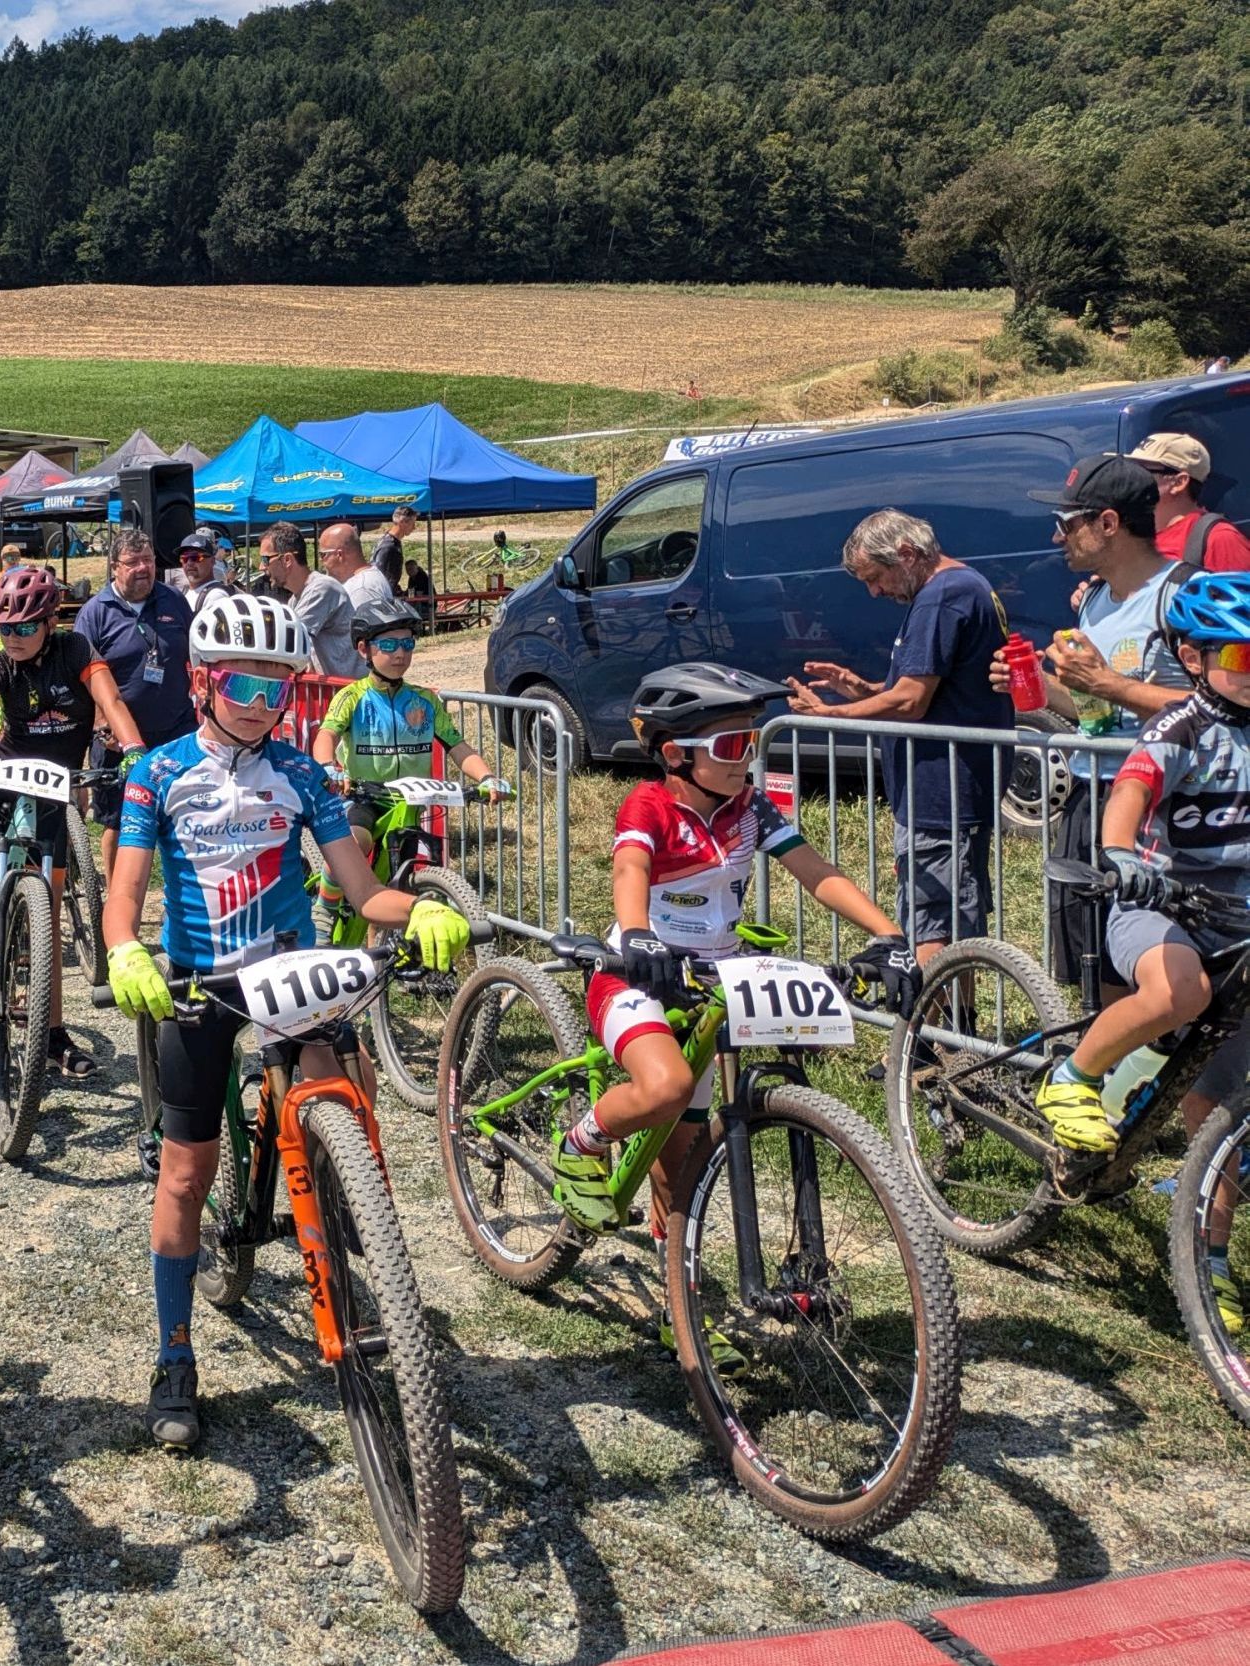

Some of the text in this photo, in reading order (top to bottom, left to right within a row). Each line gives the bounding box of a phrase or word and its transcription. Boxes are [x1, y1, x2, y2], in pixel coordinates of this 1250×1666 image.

[273, 471, 344, 483] SHERCO
[267, 499, 335, 513] SHERCO
[351, 494, 418, 505] SHERCO
[1156, 699, 1198, 733] GIANT
[1194, 691, 1237, 722] GIANT
[2, 765, 66, 789] 1107
[182, 816, 268, 844] Sparkasse
[253, 956, 369, 1016] 1103
[733, 979, 843, 1018] 1102
[302, 1249, 327, 1309] FOX
